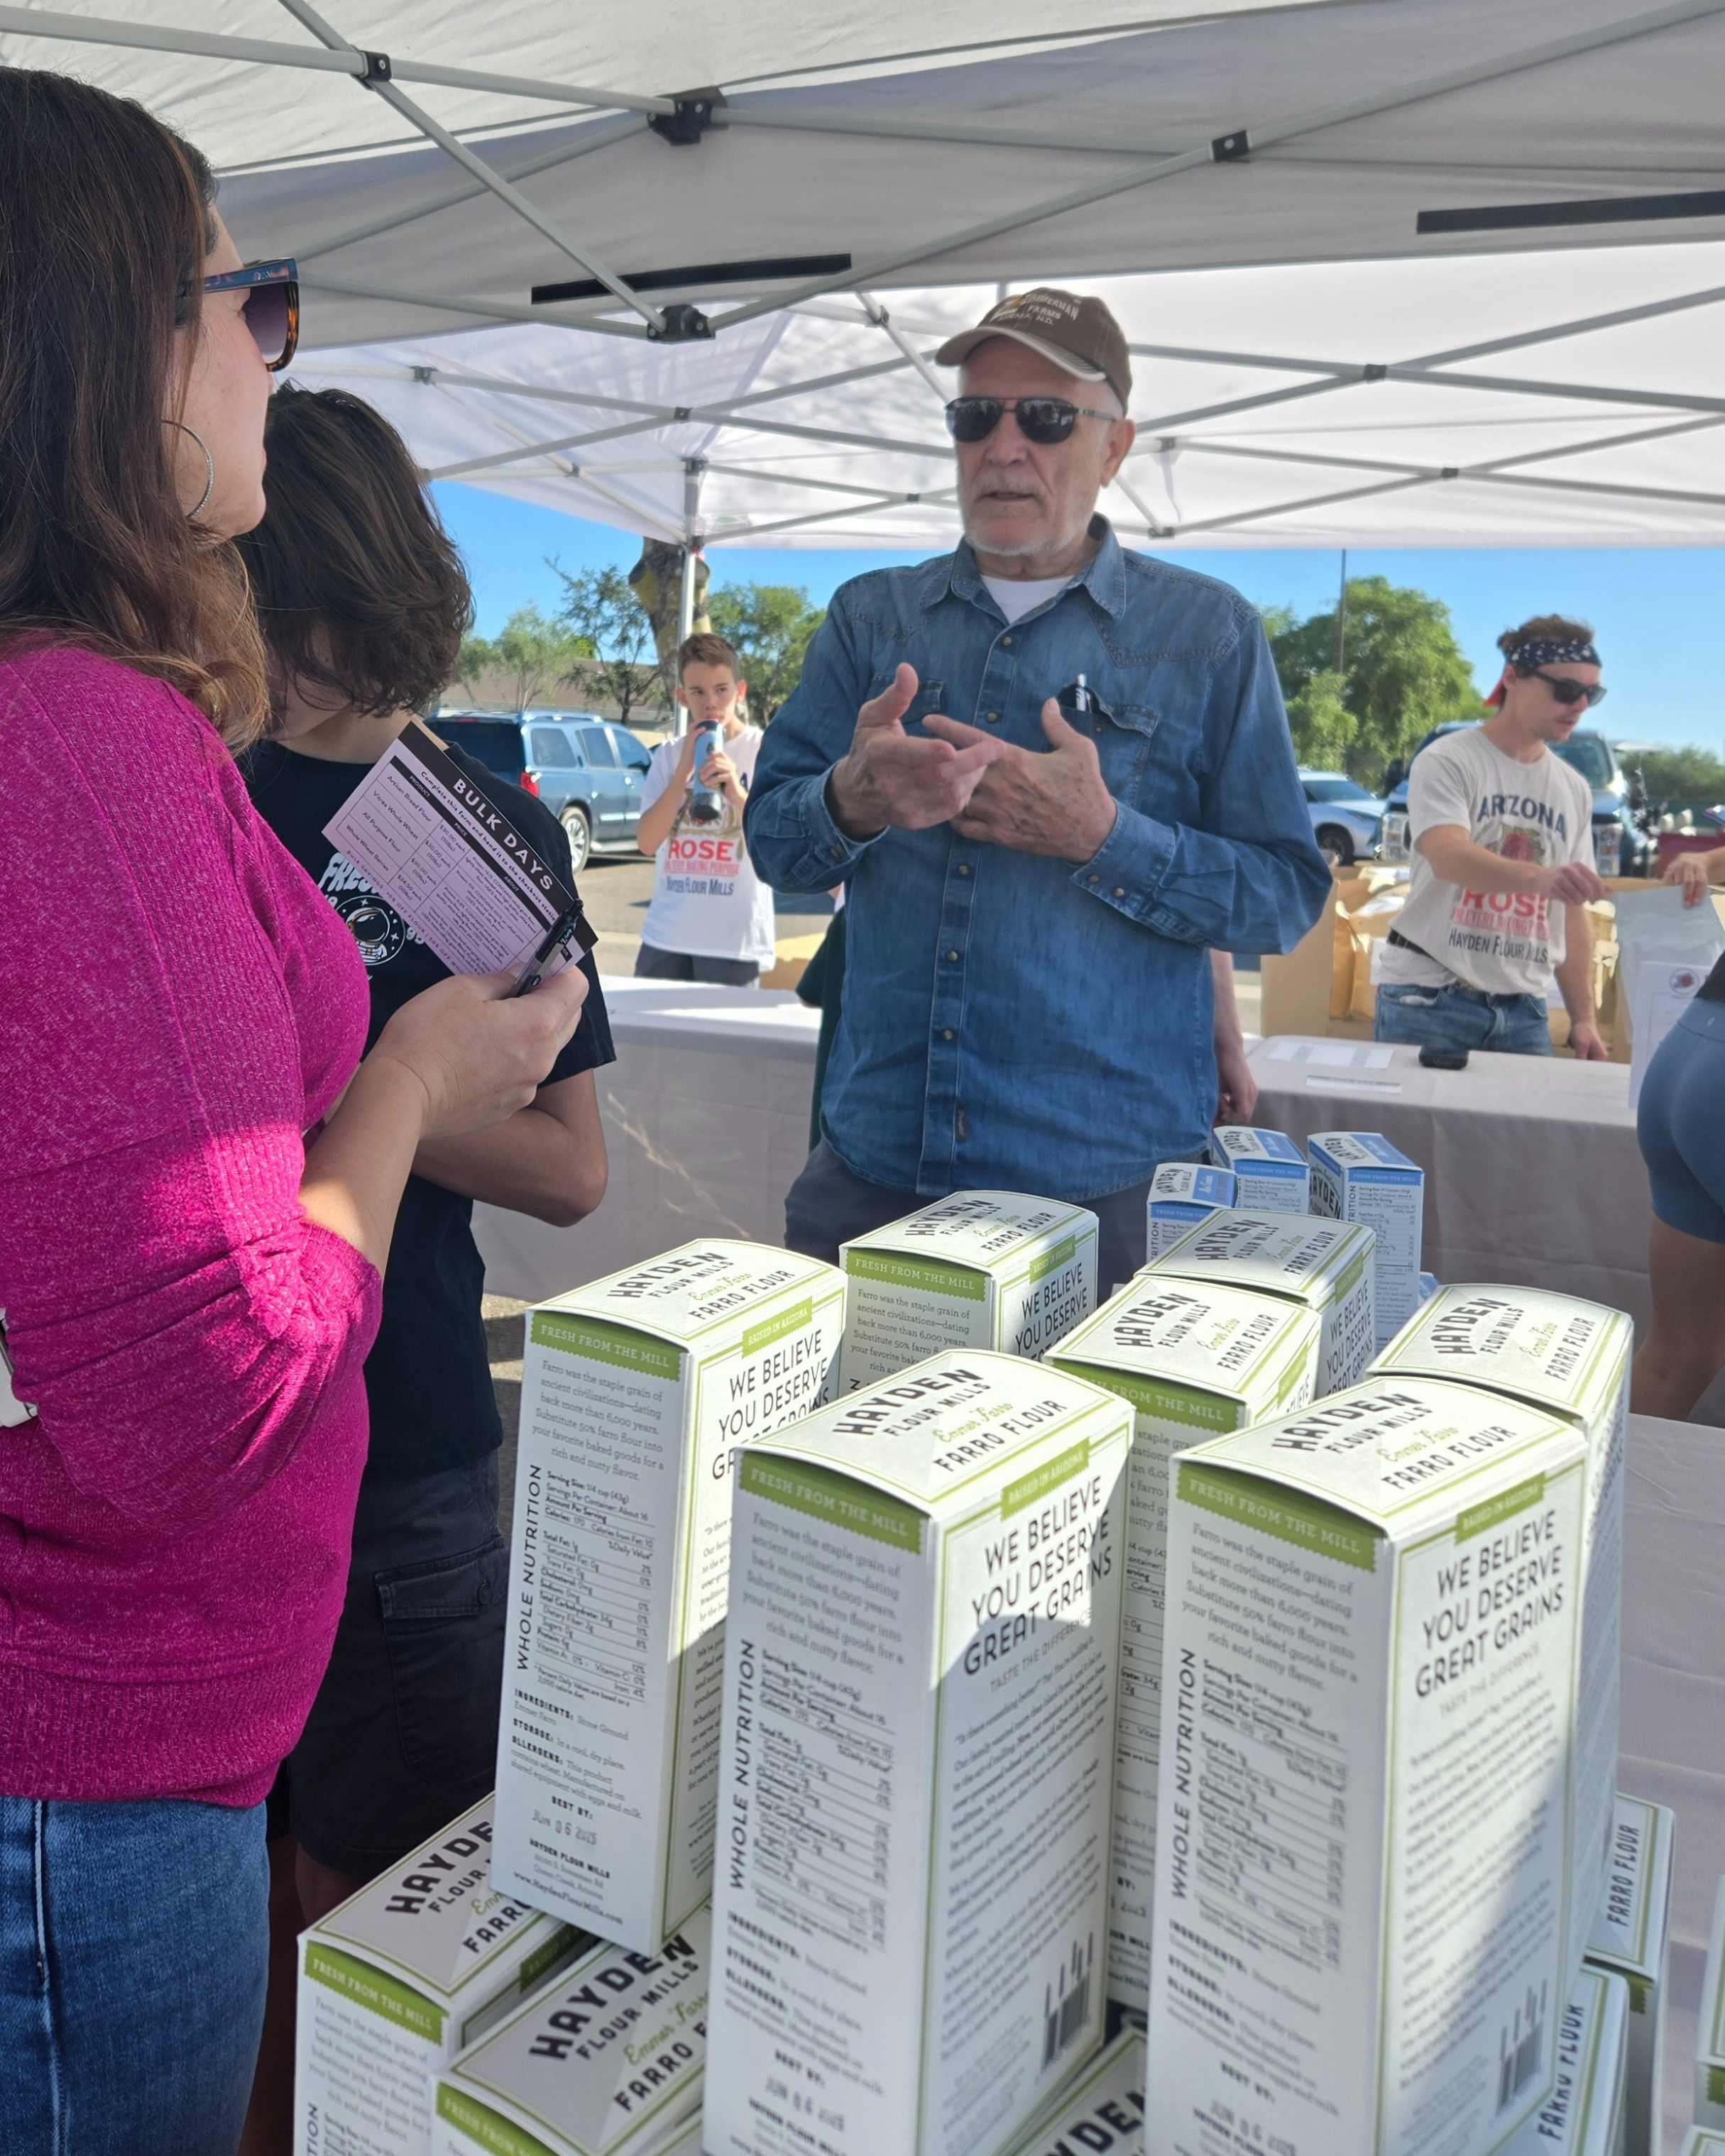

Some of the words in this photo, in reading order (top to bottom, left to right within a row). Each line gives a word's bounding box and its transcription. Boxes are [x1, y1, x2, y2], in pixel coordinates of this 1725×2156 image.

[1022, 293, 1078, 320] ZIMMERMAN
[1028, 305, 1061, 319] FARMS
[1036, 314, 1053, 326] N.D.
[373, 790, 387, 807] Vitrea
[388, 805, 402, 823] Whole
[402, 821, 417, 840] Wheat
[386, 776, 404, 794] Artisan
[404, 793, 419, 809] Bread
[417, 807, 432, 821] Flour
[1477, 794, 1566, 844] ARZONA
[346, 824, 360, 840] Whole
[360, 839, 374, 855] Wheat
[373, 854, 388, 871] Berries
[369, 818, 388, 840] Purpose
[388, 837, 400, 852] Flour
[409, 775, 430, 797] PRODUCT
[454, 823, 467, 836] PRICE
[503, 876, 519, 891] ABOUT
[421, 771, 446, 799] Complete
[447, 799, 457, 811] this
[458, 810, 471, 825] form
[471, 826, 483, 837] and
[482, 836, 497, 852] hand
[508, 865, 518, 875] the
[518, 876, 541, 903] checkout
[541, 903, 558, 920] statio
[425, 840, 442, 857] $30.00
[440, 857, 450, 868] each
[439, 824, 456, 842] $30.00
[455, 842, 465, 852] each
[453, 778, 501, 830] BULK
[503, 832, 552, 889] DAYS
[668, 839, 734, 862] ROSE
[686, 876, 707, 894] FLOUR
[708, 879, 733, 896] MILLS
[1449, 928, 1491, 954] HAYDEN
[1492, 935, 1524, 959] FLOUR
[1223, 1130, 1250, 1154] HAYDEN
[1324, 1138, 1359, 1161] HAYDEN
[1155, 1167, 1183, 1194] HAYDEN
[904, 1199, 995, 1236] HAYDEN
[940, 1216, 978, 1236] FLOUR
[976, 1206, 1002, 1221] MILLS
[980, 1229, 1024, 1251] FARRO
[1019, 1212, 1057, 1232] FLOUR
[1195, 1219, 1269, 1260] HAYDEN
[1232, 1241, 1259, 1260] FLOUR
[1255, 1225, 1279, 1243] MILLS
[606, 1252, 729, 1298] HAYDEN
[855, 1258, 887, 1273] FRESH
[891, 1265, 920, 1279] FROM
[924, 1272, 945, 1283] THE
[948, 1277, 975, 1289] MILL
[1283, 1252, 1318, 1275] FARRO
[1305, 1231, 1339, 1253] FLOUR
[646, 1276, 696, 1299] FLOUR
[691, 1261, 735, 1284] MILLS
[688, 1292, 746, 1321] FARRO
[741, 1270, 796, 1295] FLOUR
[858, 1289, 878, 1301] Farro
[880, 1294, 894, 1303] was
[895, 1297, 909, 1307] the
[910, 1300, 935, 1314] staple
[936, 1306, 959, 1320] grain
[960, 1310, 970, 1319] of
[1022, 1291, 1040, 1318] WE
[1043, 1263, 1083, 1307] BELIEVE
[748, 1327, 772, 1346] RAISED
[772, 1324, 780, 1334] IN
[781, 1307, 808, 1330] ARIZONA
[1015, 1326, 1041, 1355] YOU
[1045, 1288, 1088, 1338] DESERVE
[1113, 1293, 1199, 1348] HAYDEN
[1157, 1322, 1192, 1348] FLOUR
[1180, 1304, 1211, 1324] MILLS
[1330, 1316, 1343, 1344] WE
[1345, 1279, 1368, 1329] BELIEVE
[1430, 1298, 1511, 1355] HAYDEN
[1479, 1330, 1510, 1355] FLOUR
[1496, 1307, 1524, 1329] MILLS
[541, 1324, 576, 1343] FRESH
[579, 1336, 610, 1352] FROM
[614, 1344, 637, 1359] THE
[640, 1351, 669, 1368] MILL
[730, 1366, 756, 1402] WE
[762, 1329, 821, 1385] BELIEVE
[1217, 1341, 1256, 1371] FARRO
[1242, 1314, 1278, 1342] FLOUR
[1327, 1346, 1345, 1378] YOU
[1346, 1304, 1371, 1359] DESERVE
[1544, 1347, 1580, 1382] FARRO
[1562, 1317, 1595, 1348] FLOUR
[542, 1360, 564, 1375] Farro
[566, 1369, 581, 1379] was
[583, 1372, 596, 1384] the
[598, 1380, 625, 1395] staple
[627, 1385, 651, 1399] grain
[653, 1391, 663, 1402] of
[718, 1408, 756, 1442] YOU
[762, 1357, 828, 1419] DESERVE
[832, 1369, 984, 1436] HAYDEN
[1112, 1384, 1151, 1404] FROM
[1156, 1395, 1185, 1411] THE
[1189, 1402, 1225, 1421] MILL
[882, 1408, 944, 1437] FLOUR
[937, 1382, 991, 1408] MILLS
[1271, 1393, 1425, 1452] HAYDEN
[1323, 1428, 1384, 1454] FLOUR
[1379, 1407, 1433, 1430] MILLS
[933, 1432, 1005, 1472] FARRO
[1000, 1399, 1068, 1436] FLOUR
[1381, 1453, 1455, 1490] FARRO
[1447, 1425, 1517, 1458] FLOUR
[522, 1463, 542, 1584] NUTRITION
[985, 1530, 1019, 1577] WE
[1028, 1475, 1101, 1552] BELIEVE
[973, 1573, 1019, 1628] YOU
[1029, 1508, 1110, 1595] DESERVE
[1438, 1556, 1471, 1600] WE
[1479, 1509, 1555, 1578] BELIEVE
[963, 1601, 1040, 1676] GREAT
[1046, 1546, 1112, 1621] GRAINS
[1423, 1597, 1469, 1650] YOU
[1479, 1544, 1564, 1620] DESERVE
[517, 1593, 534, 1671] WHOLE
[1415, 1629, 1489, 1698] GREAT
[1494, 1582, 1564, 1650] GRAINS
[515, 1688, 574, 1721] INGREDIENTS:
[736, 1639, 755, 1788] NUTRITION
[513, 1718, 554, 1743] STORAGE:
[552, 1795, 574, 1811] BEST
[577, 1806, 593, 1820] BY:
[729, 1791, 750, 1890] WHOLE
[1614, 1823, 1641, 1872] FLOUR
[385, 1821, 493, 1914] HAYDE
[427, 1869, 486, 1913] FLOUR
[1607, 1874, 1634, 1927] FARRO
[462, 1900, 533, 1953] FARR
[528, 1934, 696, 2061] HAYDEN
[576, 2007, 641, 2059] FLOUR
[641, 1961, 699, 2006] MILLS
[613, 2042, 693, 2112] FARRO
